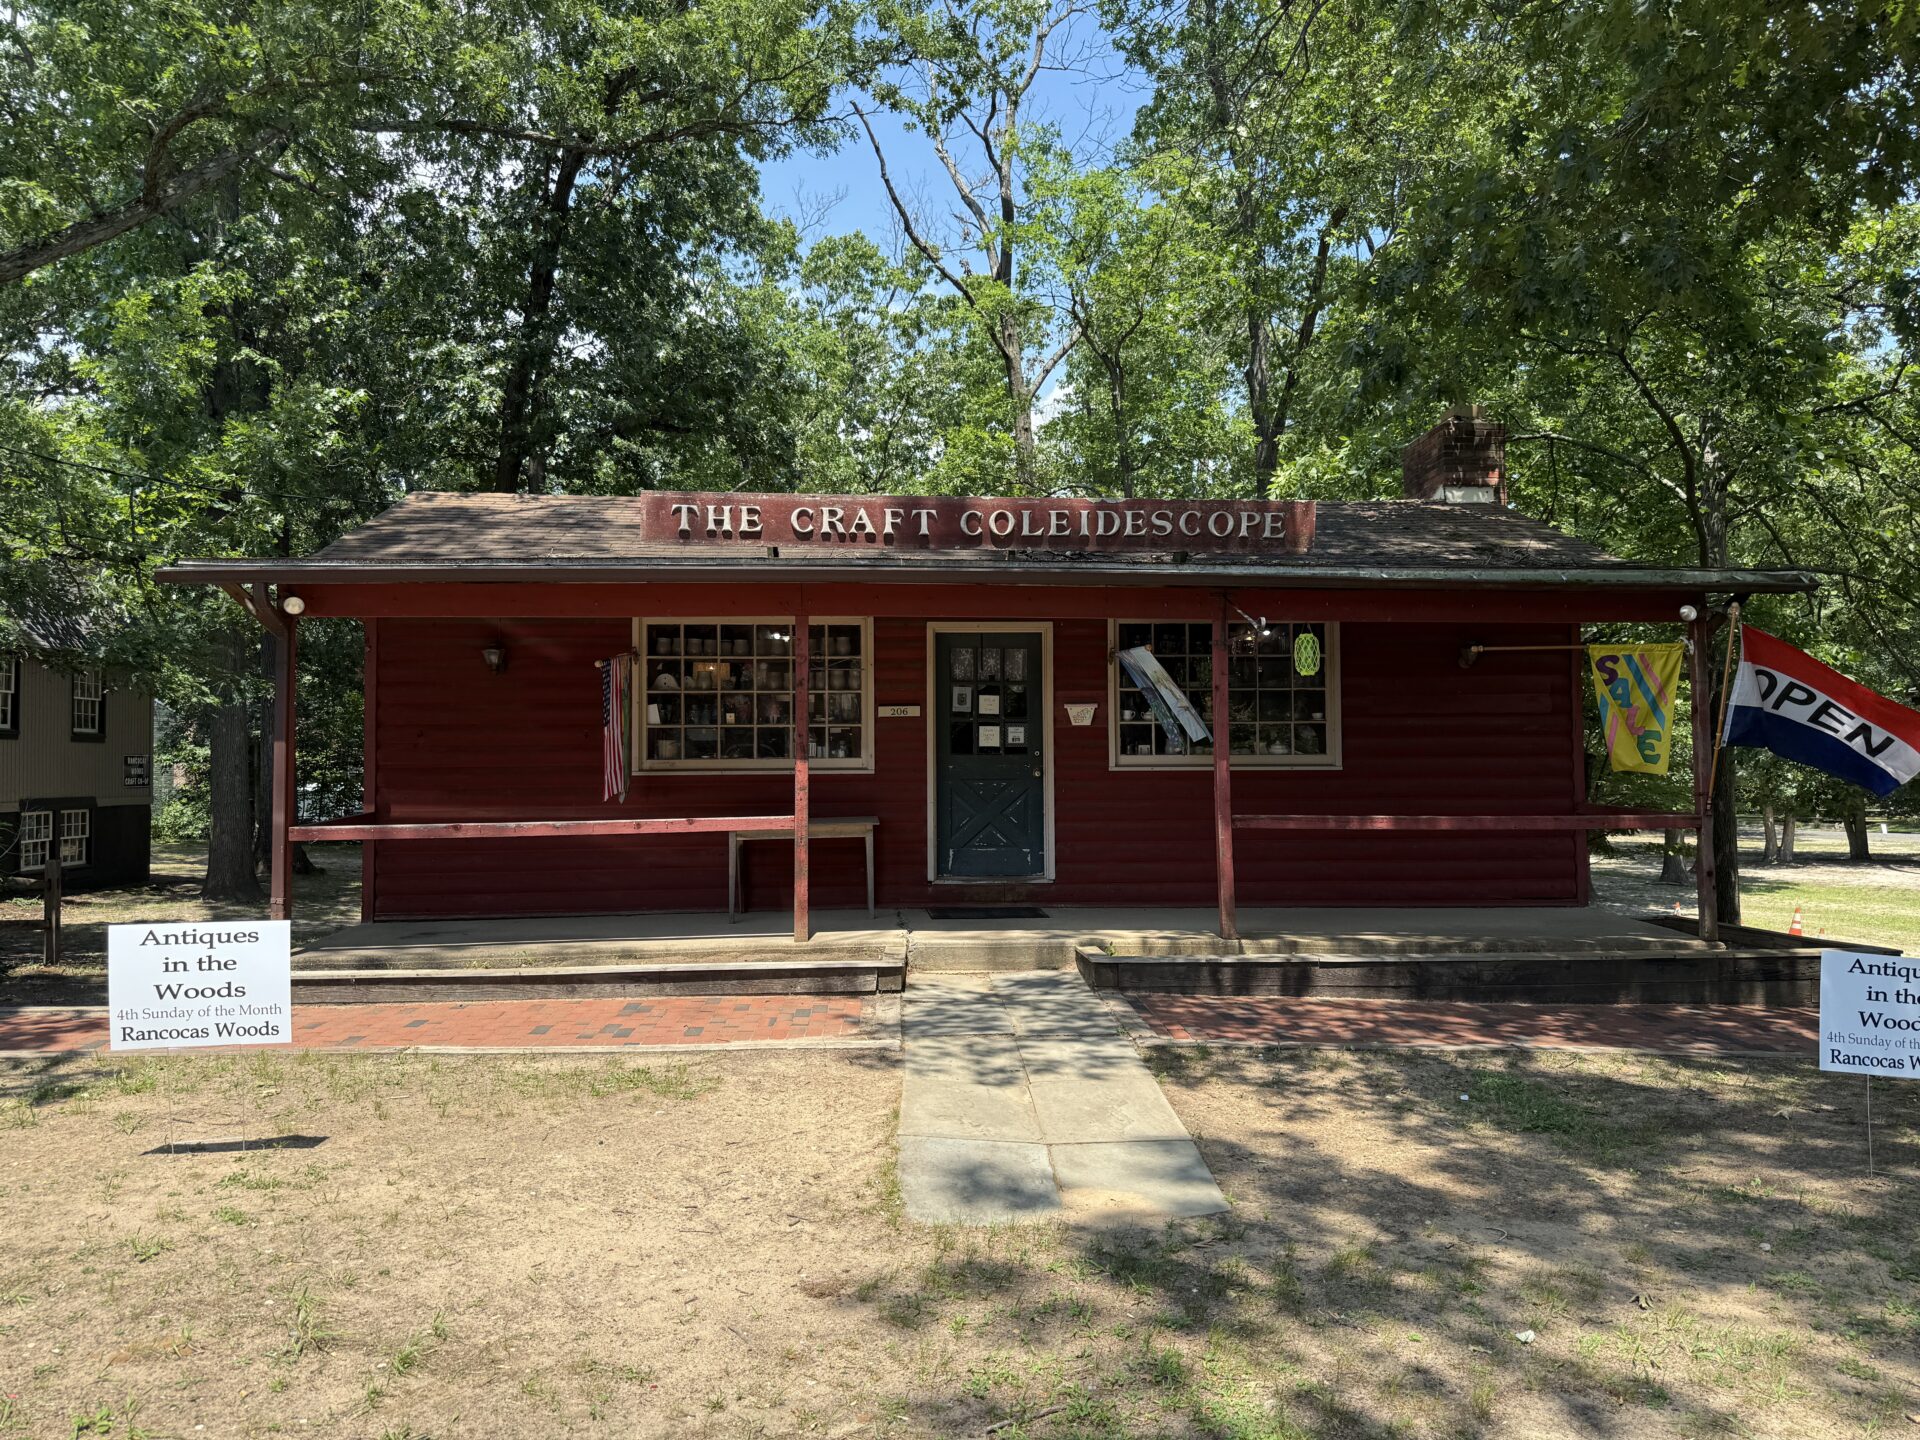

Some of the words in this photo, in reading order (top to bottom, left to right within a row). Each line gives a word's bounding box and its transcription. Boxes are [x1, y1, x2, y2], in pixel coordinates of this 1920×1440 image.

[671, 504, 764, 532] THE
[790, 507, 938, 537] CRAFT
[959, 509, 1287, 539] COLEIDESCOPE
[890, 707, 909, 716] 206
[1595, 654, 1661, 765] SALE
[1755, 669, 1895, 758] OPEN
[139, 928, 260, 950] Antiques
[162, 956, 190, 973] in
[197, 955, 238, 972] the
[153, 981, 247, 1000] Woods
[1865, 985, 1889, 1003] in
[117, 1008, 139, 1021] 4th
[142, 1006, 194, 1022] Sunday
[198, 1005, 212, 1018] of
[215, 1005, 236, 1017] the
[239, 1003, 282, 1016] Month
[120, 1026, 209, 1042] Rancocas
[214, 1021, 280, 1038] Woods
[1827, 1031, 1845, 1044] 4th
[1848, 1033, 1892, 1051] Sunday
[1894, 1037, 1907, 1049] of
[1829, 1048, 1905, 1070] Rancocas
